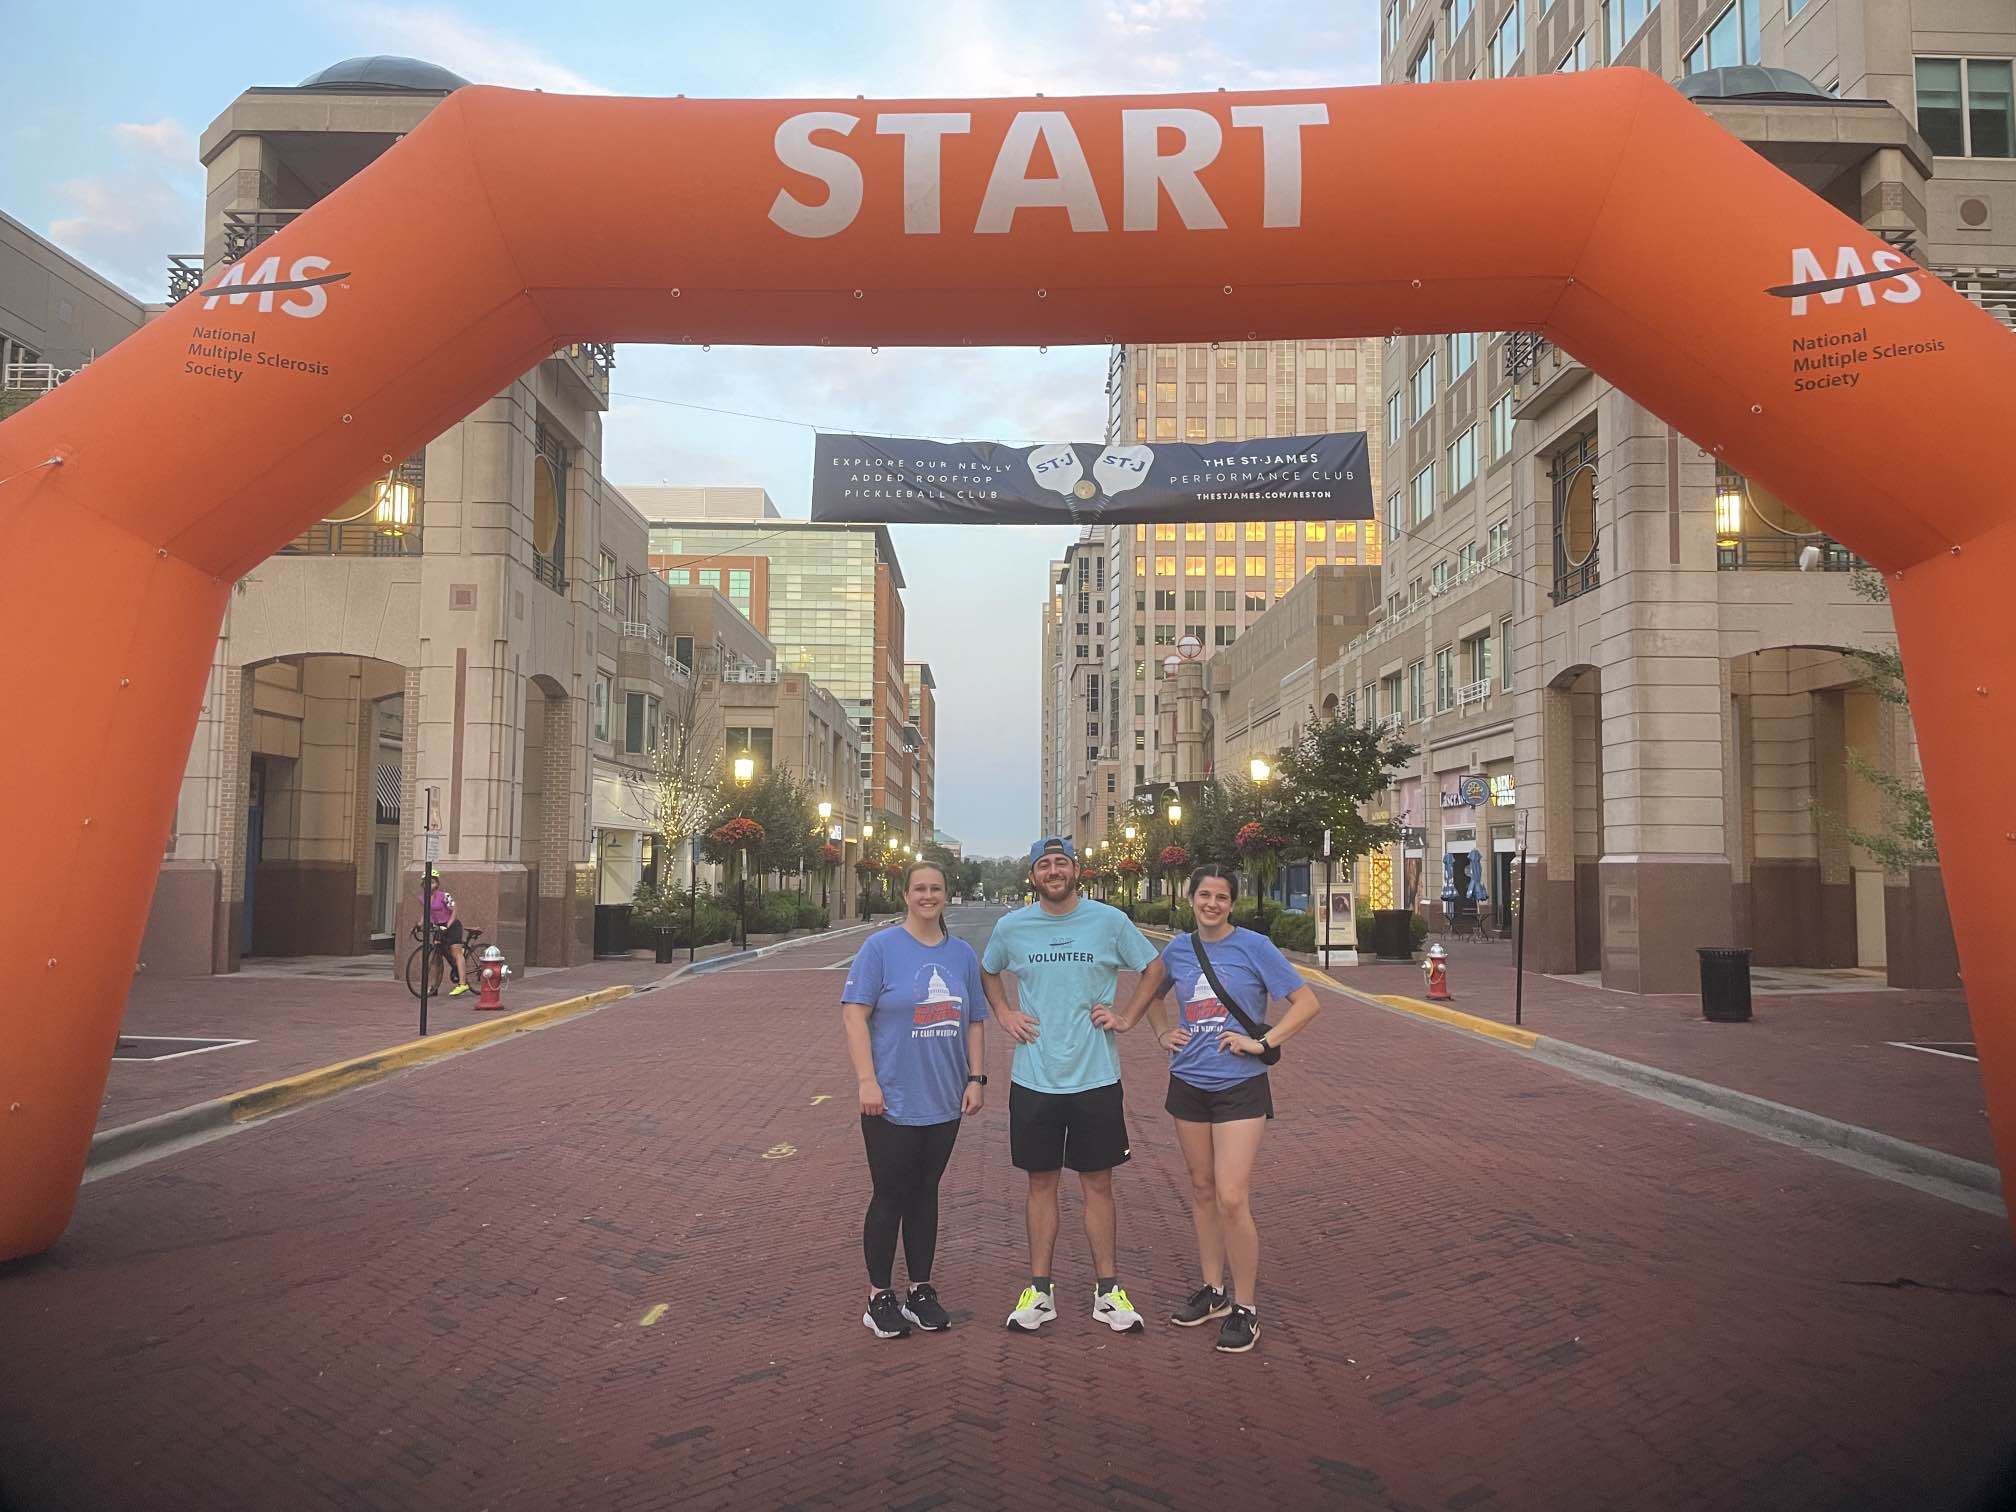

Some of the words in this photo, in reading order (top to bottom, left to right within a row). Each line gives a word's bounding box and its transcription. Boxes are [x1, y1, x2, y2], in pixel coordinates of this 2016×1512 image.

[767, 103, 1330, 238] START
[203, 255, 331, 318] MS
[1791, 246, 1921, 316] MS
[193, 326, 256, 344] National
[1792, 328, 1867, 352] National
[188, 343, 252, 363] Multiple
[256, 351, 329, 375] Sclerosis
[1793, 350, 1868, 373] Multiple
[1872, 339, 1945, 360] Sclerosis
[184, 361, 243, 383] Society
[1794, 372, 1860, 392] Society
[833, 458, 904, 468] EXPLORE
[916, 460, 947, 468] OUR
[959, 461, 1011, 472] NEWLY
[1203, 456, 1234, 467] THE
[851, 474, 904, 482] ADDED
[916, 475, 993, 483] ROOFTOP
[1170, 471, 1301, 484] PERFORMANCE
[1312, 471, 1354, 481] CLUB
[845, 489, 945, 498] PICKLEBALL
[957, 490, 998, 499] CLUB
[1196, 491, 1331, 500] THESTJAMES.COM/RESTON
[1028, 952, 1094, 963] VOLUNTEER
